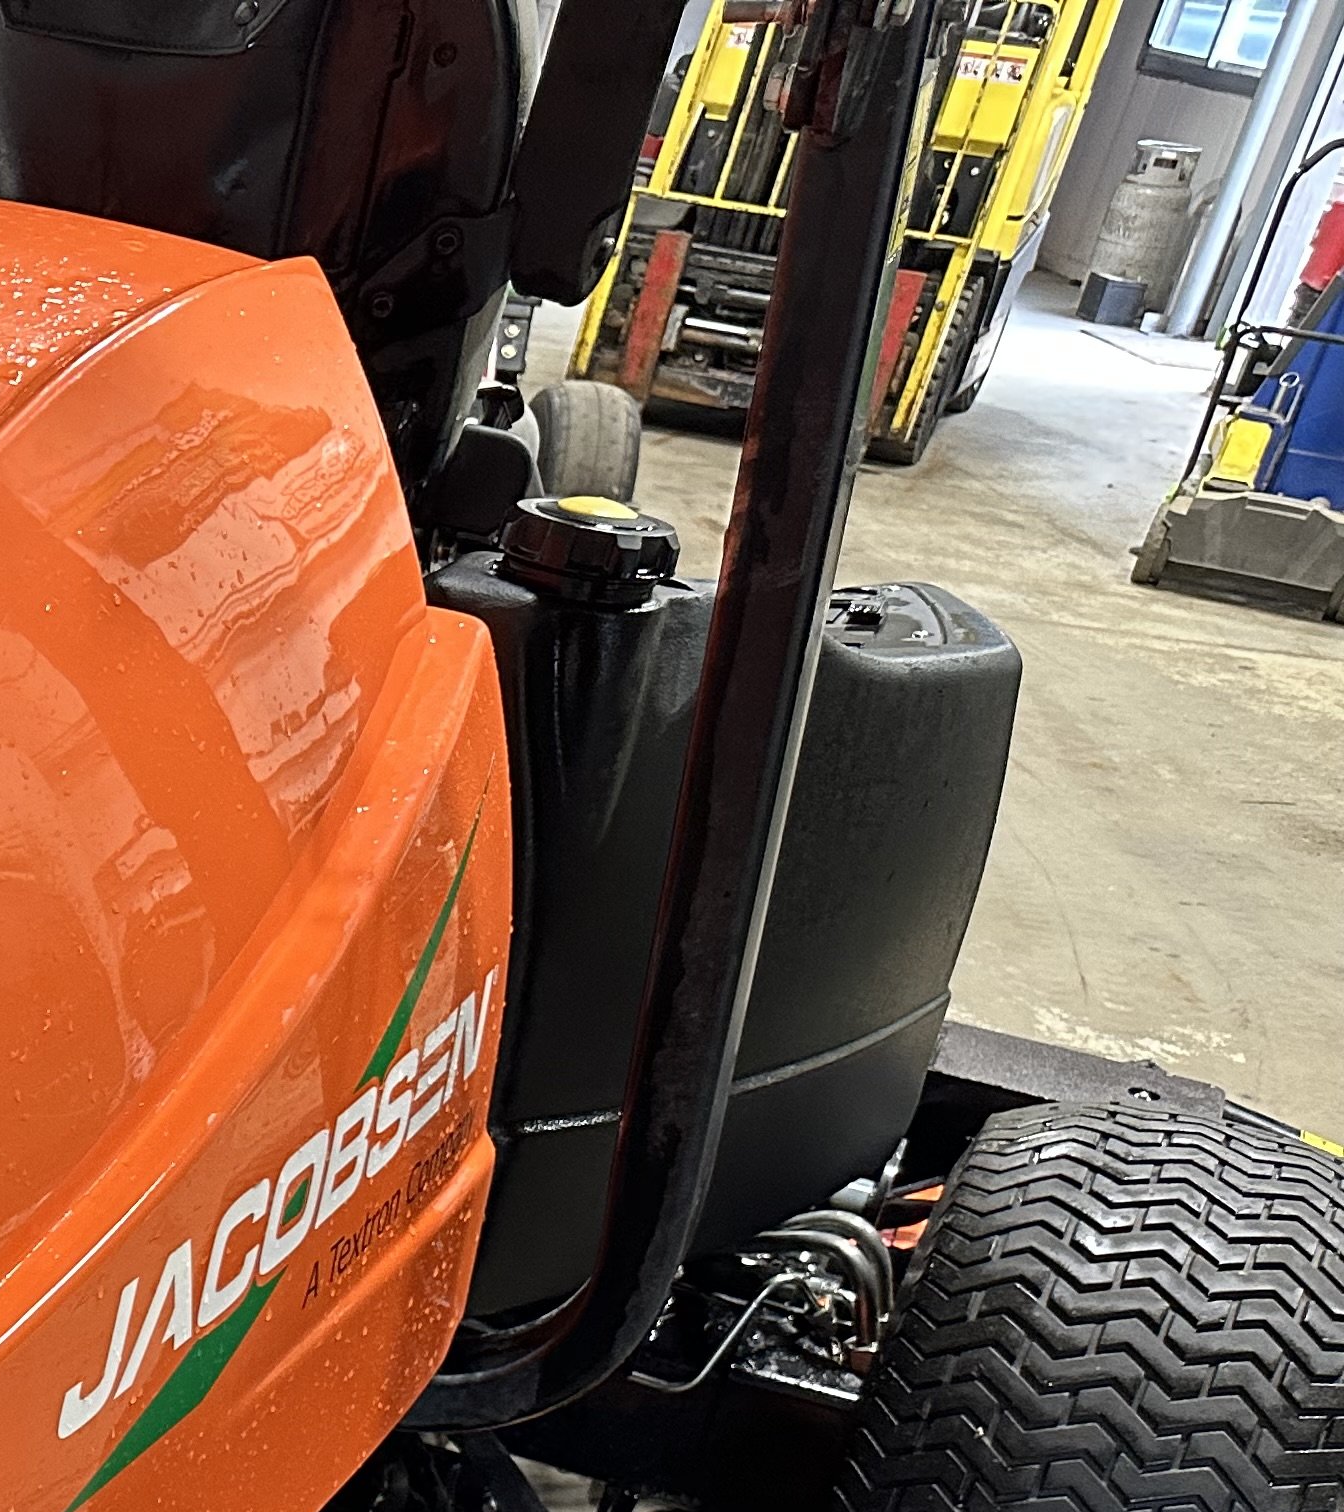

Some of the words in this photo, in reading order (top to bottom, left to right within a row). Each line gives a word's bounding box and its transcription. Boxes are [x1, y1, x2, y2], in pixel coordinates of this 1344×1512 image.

[58, 968, 494, 1440] JACOBSEN
[301, 1260, 319, 1311] A
[329, 1188, 402, 1283] Textron
